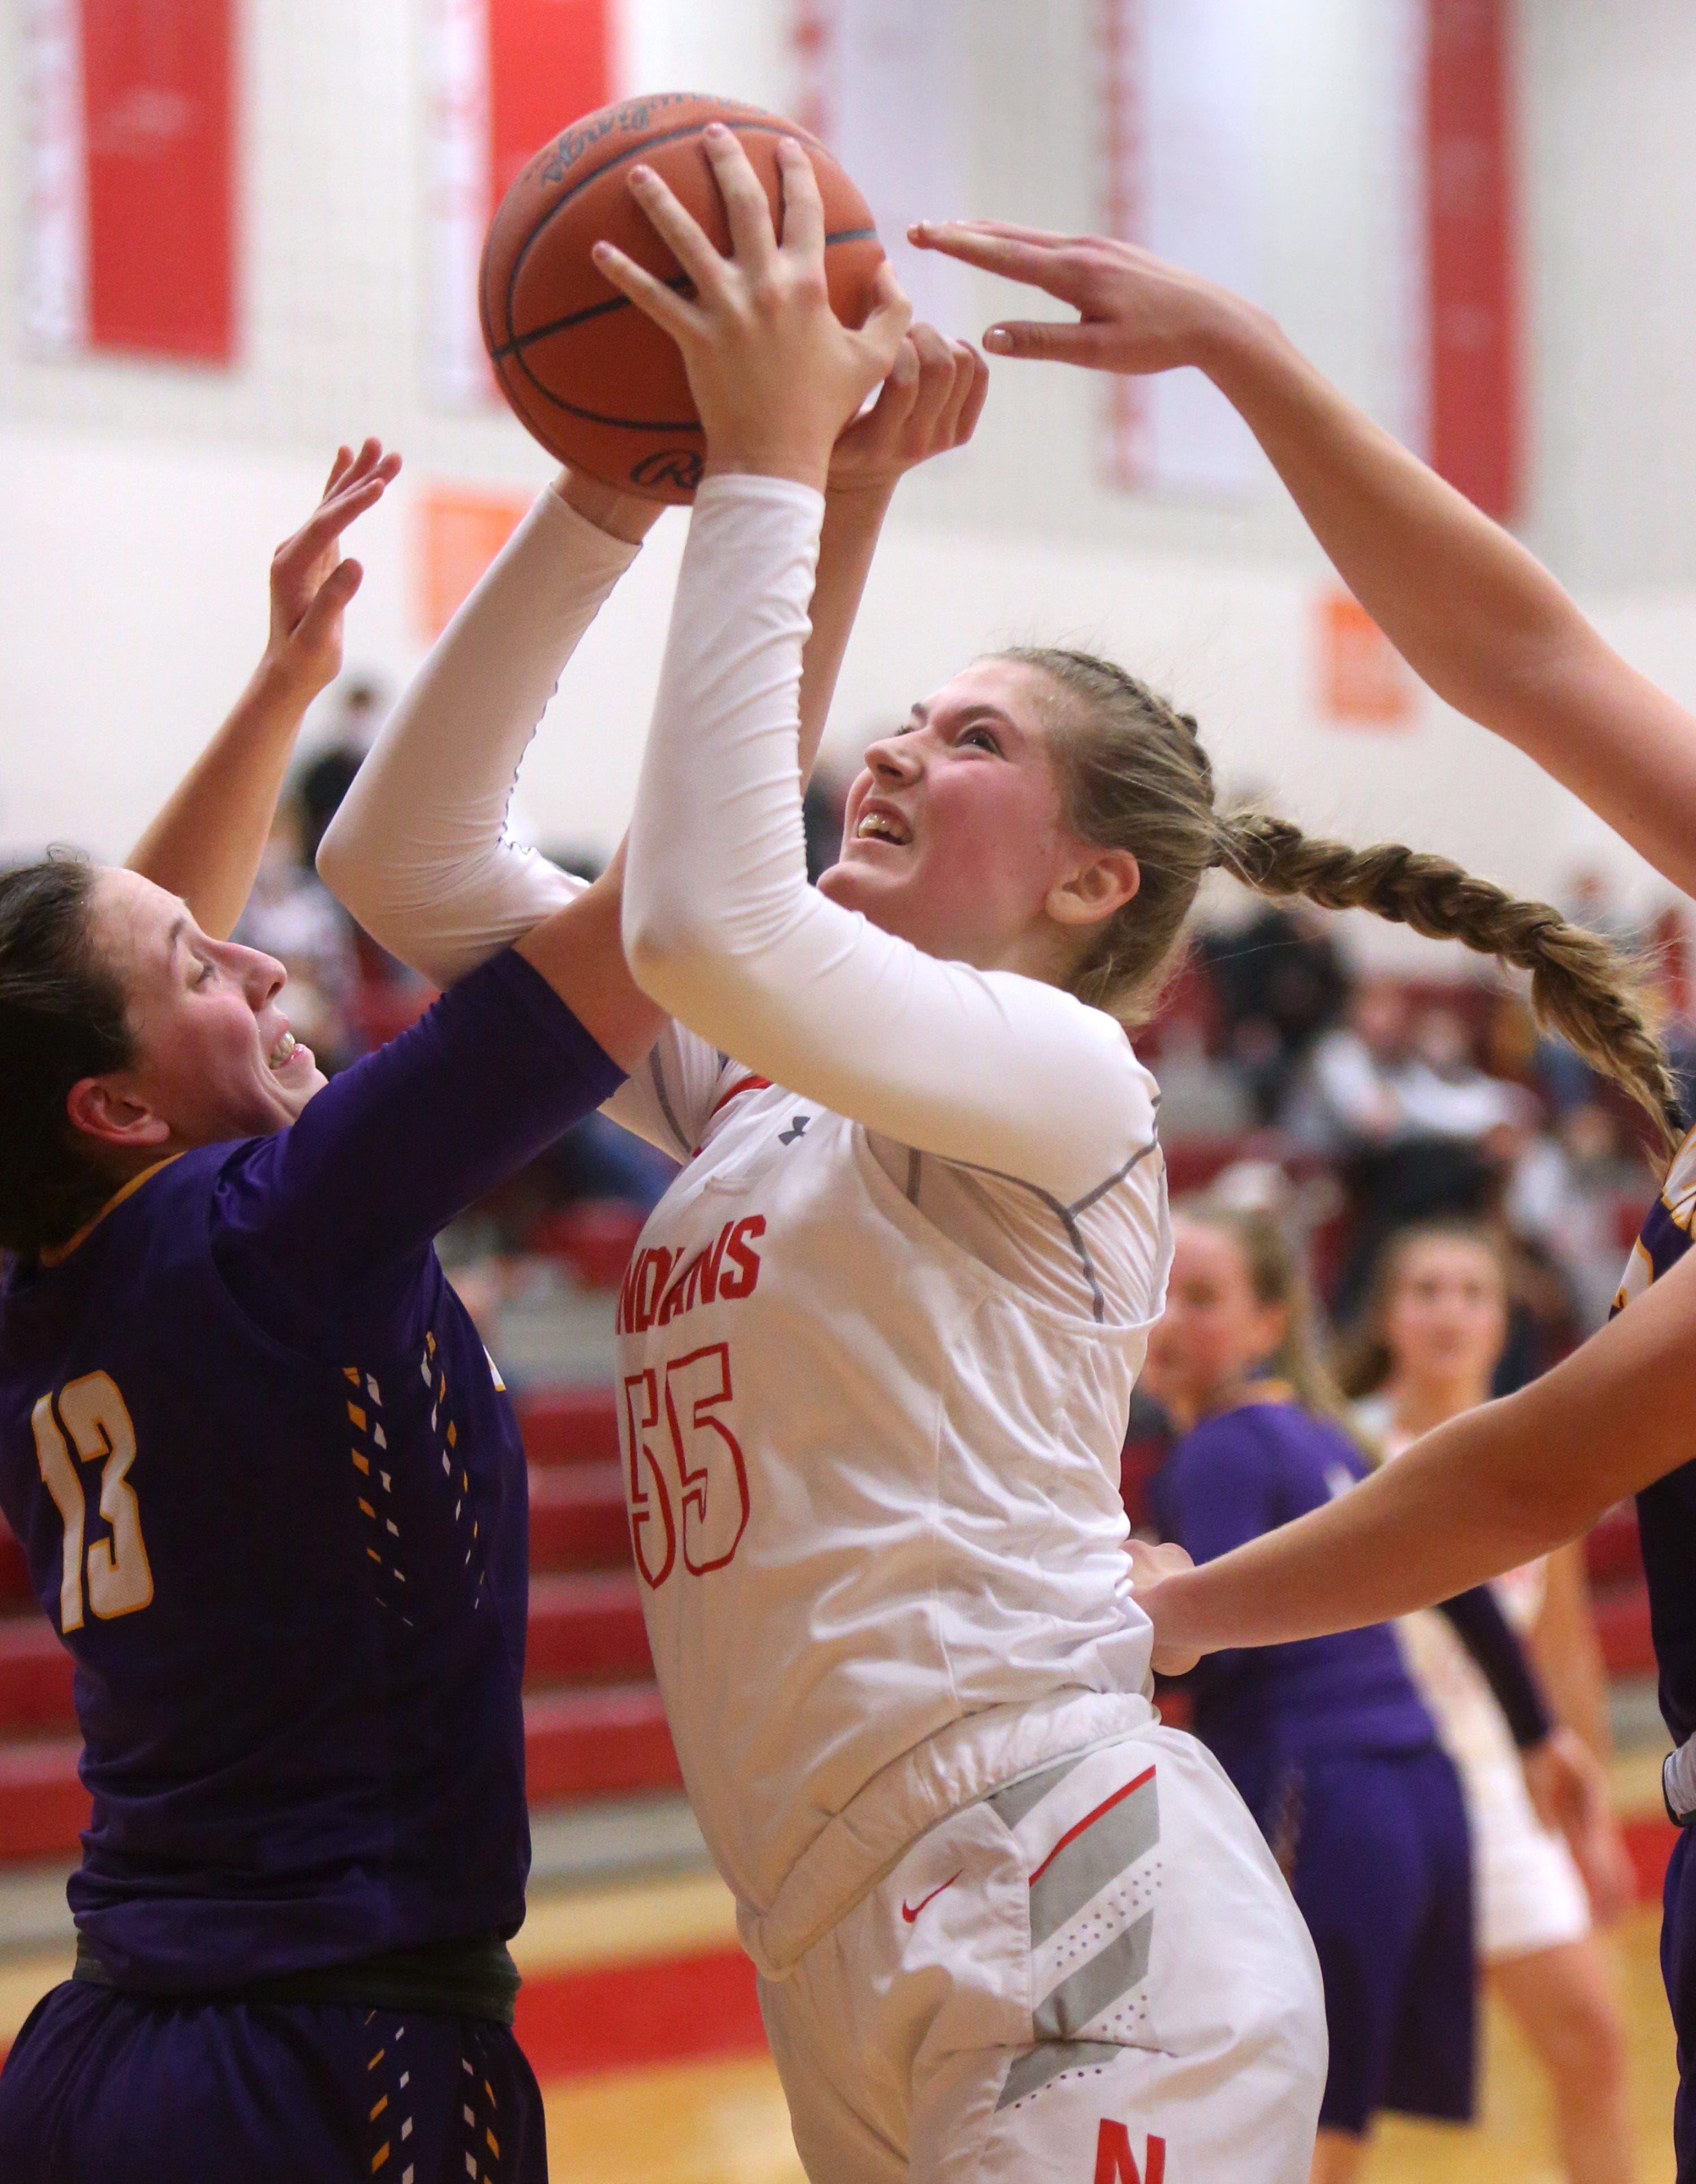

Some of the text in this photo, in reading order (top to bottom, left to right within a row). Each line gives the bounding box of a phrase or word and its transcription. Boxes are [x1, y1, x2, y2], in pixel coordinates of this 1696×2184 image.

[615, 1214, 767, 1335] NDIANS
[31, 1369, 154, 1634] 13
[624, 1341, 751, 1591] 55
[1093, 2117, 1166, 2184] N
